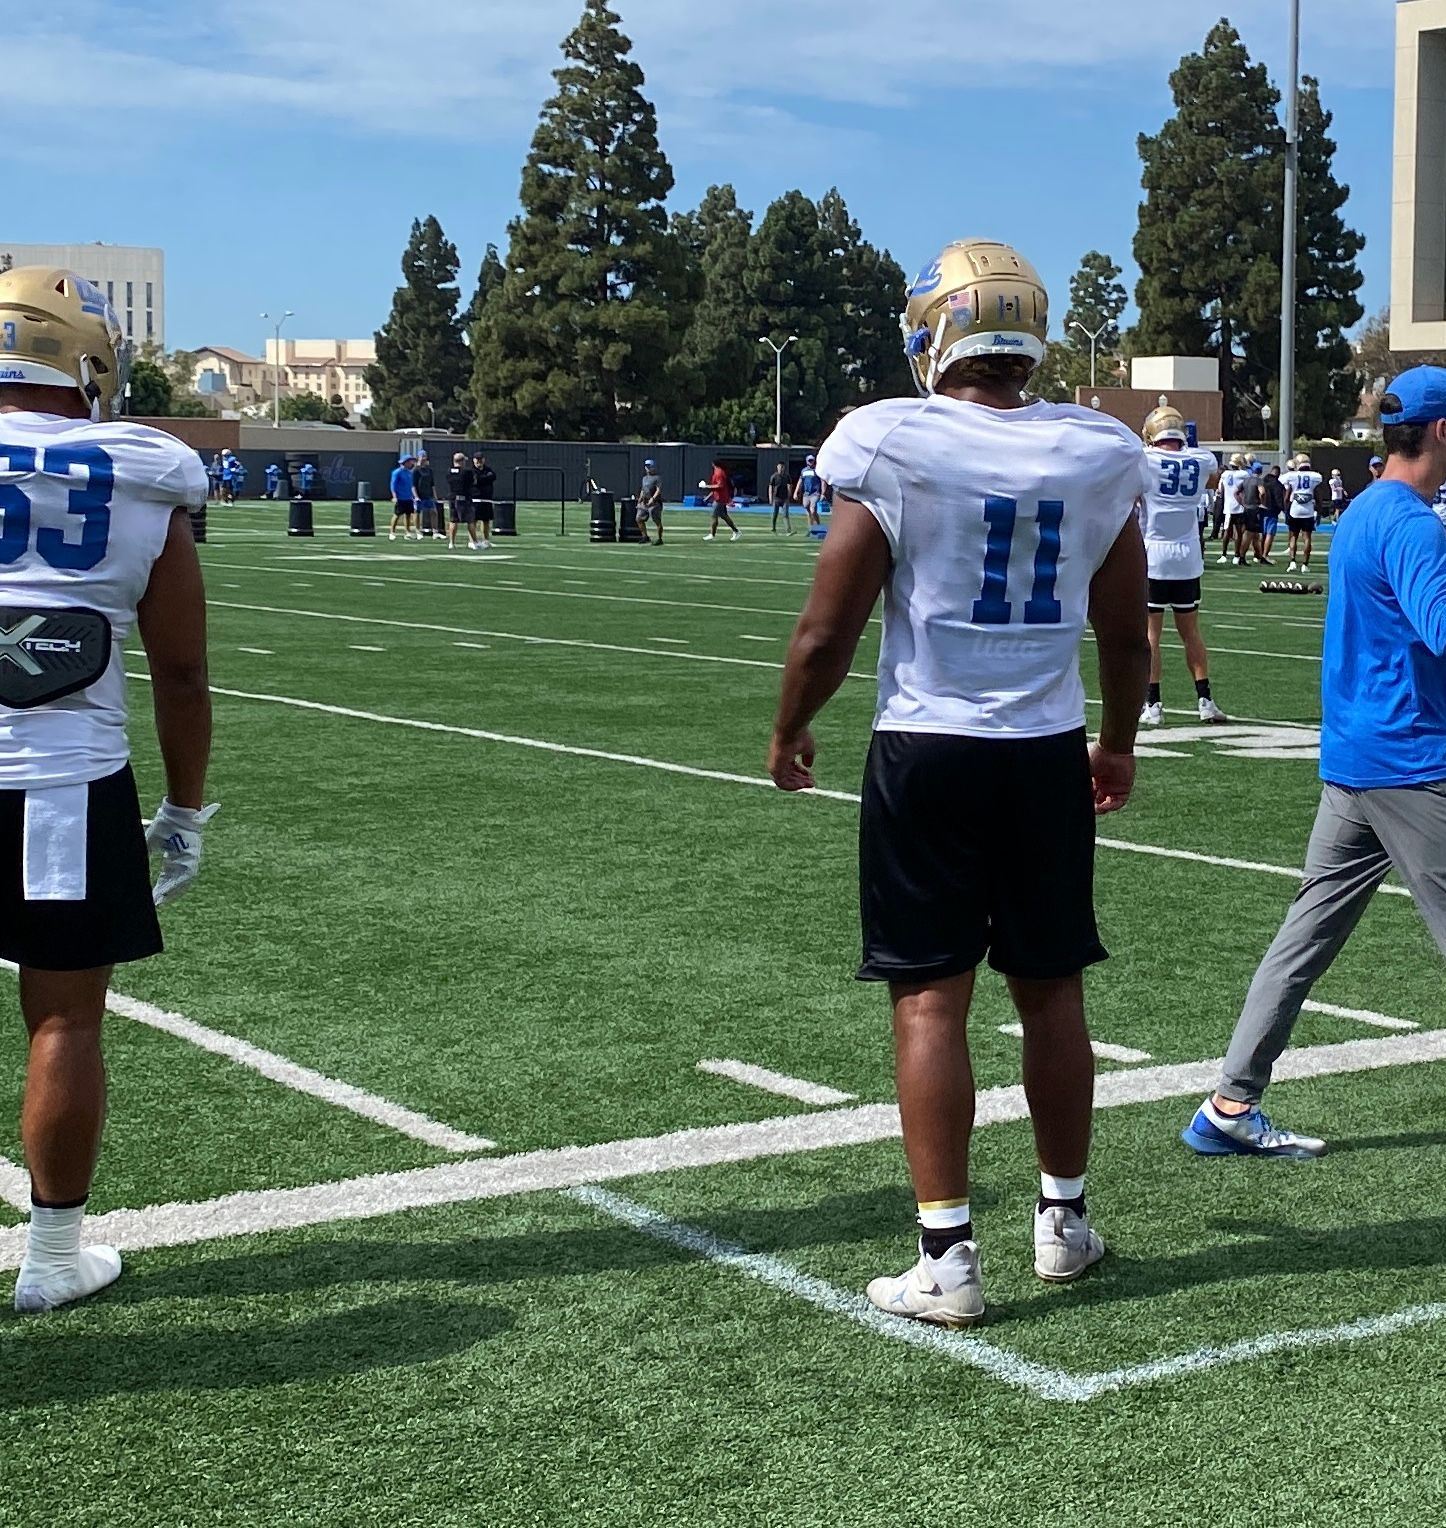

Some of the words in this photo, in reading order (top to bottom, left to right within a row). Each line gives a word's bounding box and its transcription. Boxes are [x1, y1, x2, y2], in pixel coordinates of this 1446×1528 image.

[1160, 459, 1199, 496] 33
[1297, 475, 1311, 489] 18
[971, 496, 1063, 624] 11
